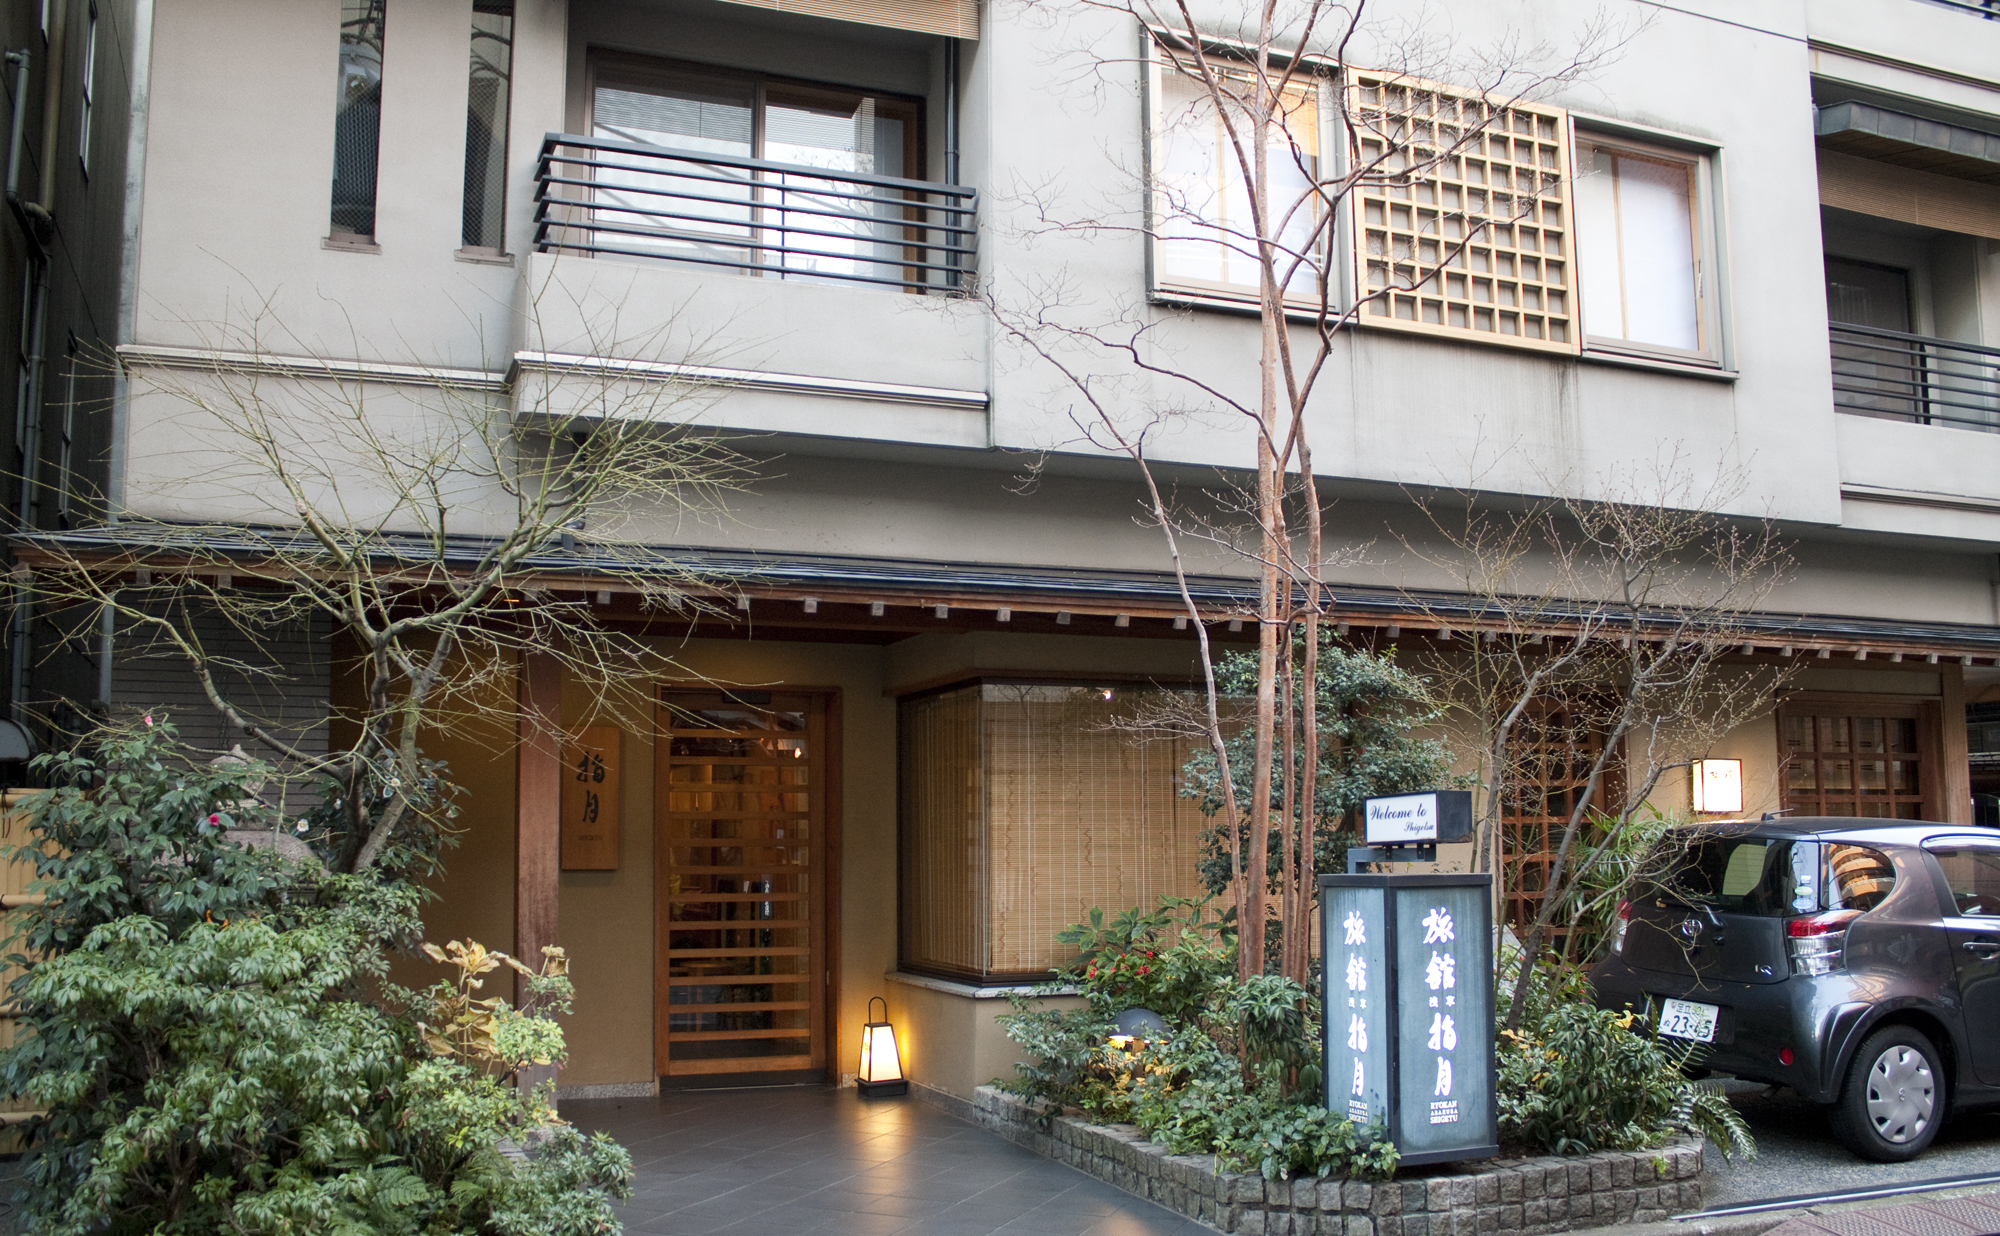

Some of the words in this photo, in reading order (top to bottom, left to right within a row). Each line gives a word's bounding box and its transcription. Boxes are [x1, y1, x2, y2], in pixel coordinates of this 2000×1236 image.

[576, 751, 606, 823] 指月
[1370, 805, 1413, 820] Welcome
[1417, 803, 1428, 817] to
[1347, 1012, 1368, 1097] 指月
[1427, 1011, 1457, 1097] 指月
[1349, 1099, 1368, 1110] RYOKAN
[1430, 1100, 1457, 1110] RYOKAN
[1430, 1108, 1458, 1116] ASAKUSA
[1430, 1114, 1458, 1124] SHIGETU
